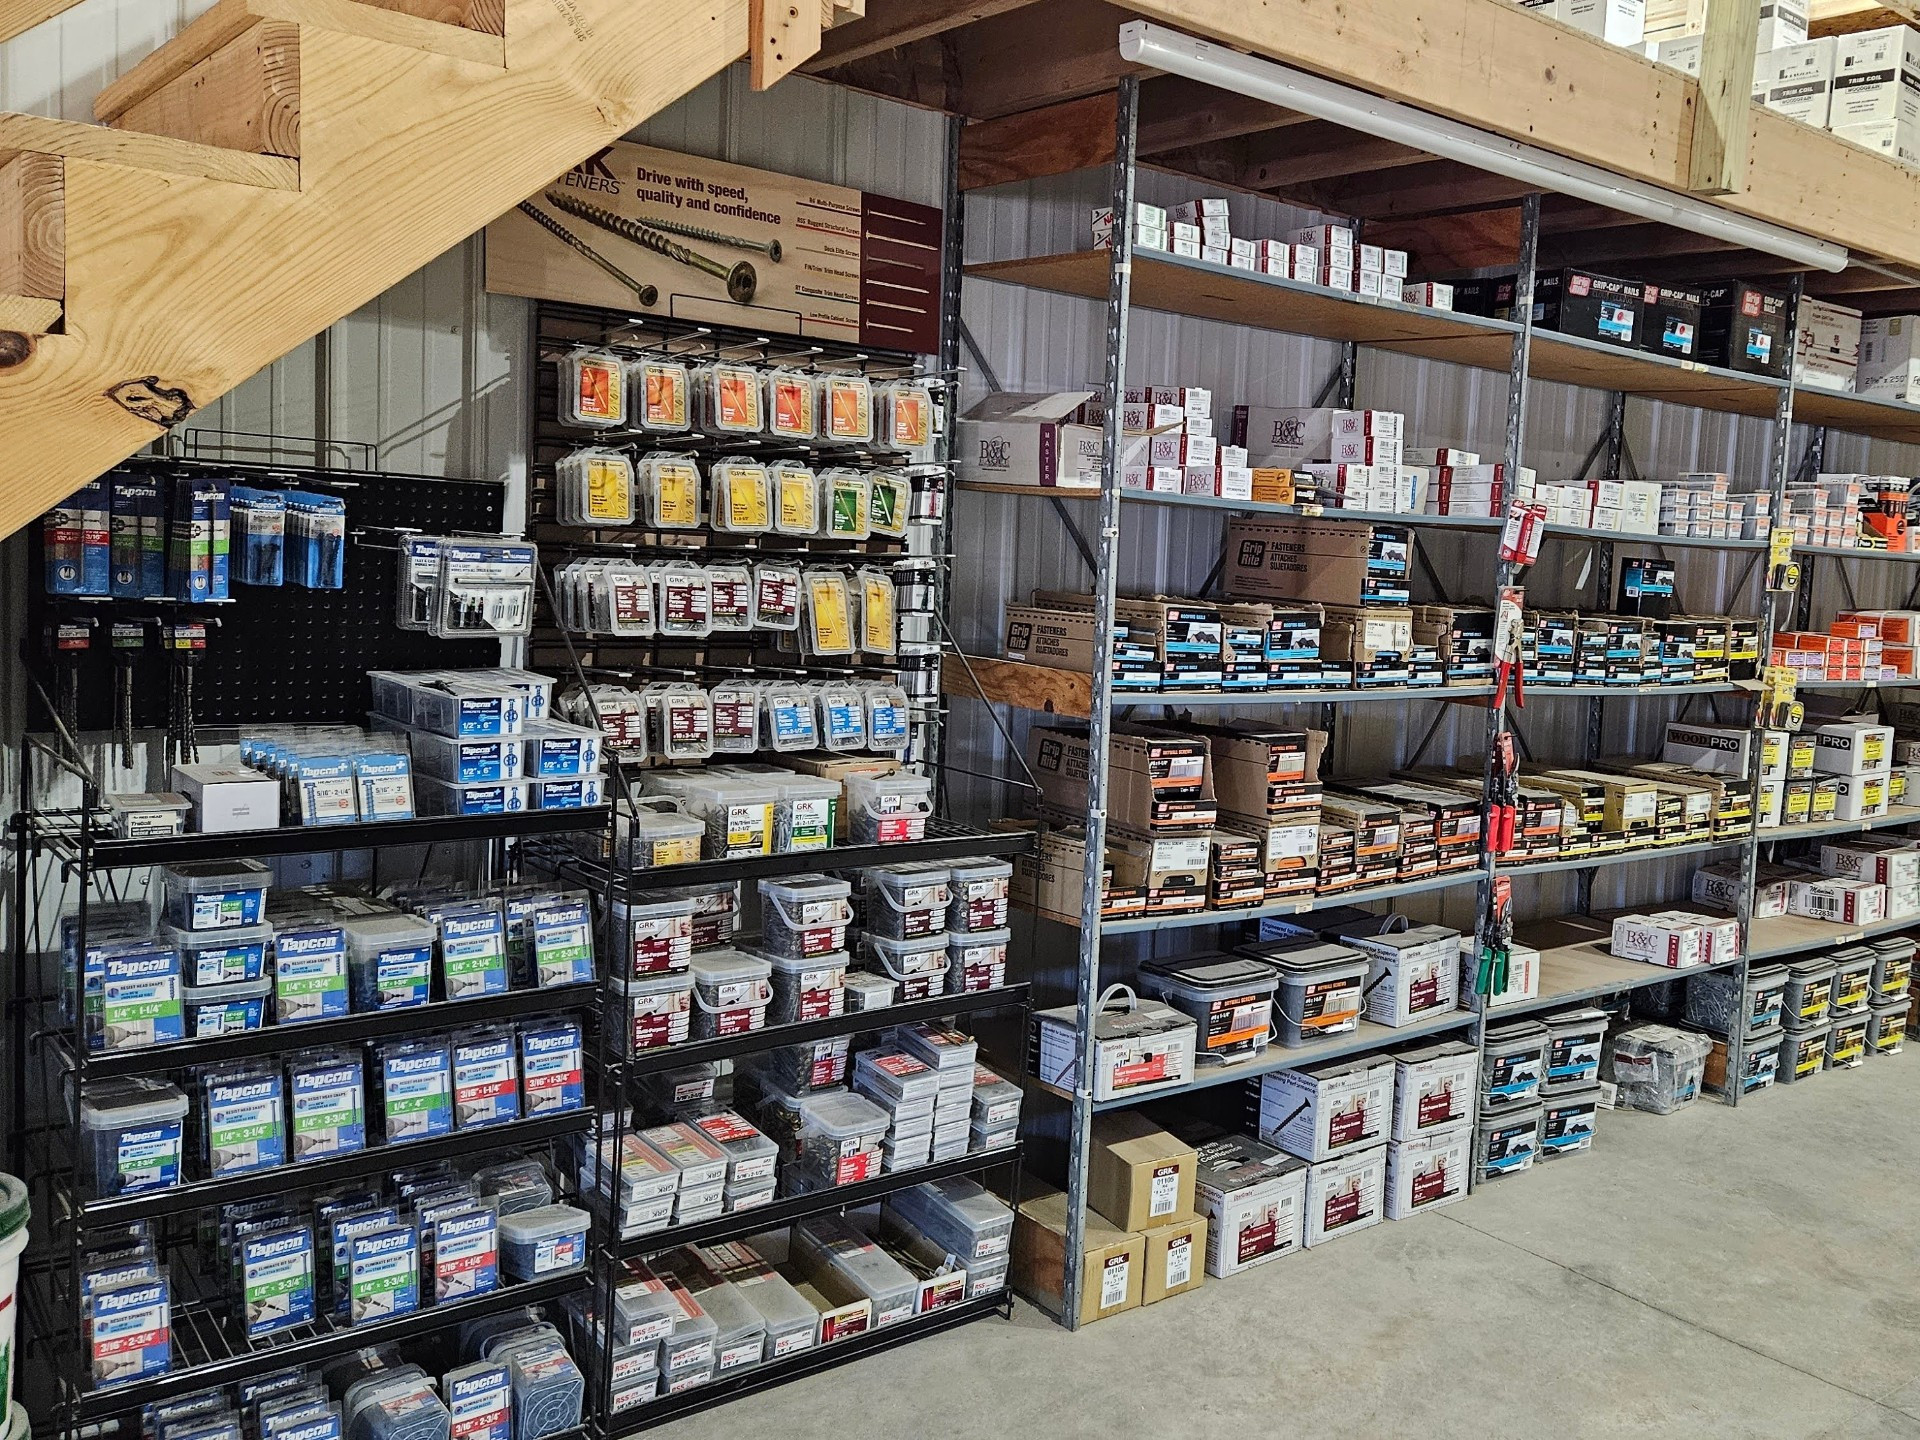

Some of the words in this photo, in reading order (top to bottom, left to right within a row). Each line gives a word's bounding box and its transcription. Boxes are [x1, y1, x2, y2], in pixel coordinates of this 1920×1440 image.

[1848, 76, 1865, 84] TRIM
[1866, 74, 1882, 82] COIL
[1781, 89, 1799, 97] TRIM
[1799, 86, 1814, 94] COIL
[1847, 84, 1881, 93] WOODGRAIN
[637, 166, 672, 186] Drive
[675, 176, 704, 192] with
[707, 183, 749, 203] speed,
[636, 187, 683, 209] quality
[686, 196, 710, 212] and
[714, 200, 782, 225] confidence
[817, 199, 845, 210] Multi-Purpose
[846, 205, 860, 213] Screws
[807, 219, 824, 229] Rugged
[824, 222, 844, 231] Structural
[845, 226, 860, 235] Screws
[835, 247, 844, 255] Elite
[845, 249, 860, 258] Screws
[824, 266, 833, 275] Trim
[833, 268, 844, 277] Head
[1543, 276, 1559, 287] NAILS
[801, 286, 823, 295] Composite
[824, 289, 833, 298] Trim
[833, 291, 844, 299] Head
[1623, 283, 1640, 297] NAILS
[1686, 293, 1700, 303] NAILS
[1272, 420, 1306, 439] B&C
[979, 440, 1011, 461] B&C
[1242, 541, 1263, 554] Grip
[1271, 542, 1306, 552] FASTENERS
[1240, 553, 1260, 566] Rite
[1269, 553, 1298, 563] ATTACHES
[1269, 562, 1308, 573] SUJETADORES
[1011, 625, 1030, 638] Grip
[1036, 625, 1068, 637] FASTENERS
[1009, 637, 1027, 649] Rite
[1035, 637, 1060, 647] ATTACHES
[1035, 644, 1069, 657] SUJETADORES
[462, 721, 477, 729] 1/2"
[483, 721, 492, 729] 6"
[1710, 735, 1739, 750] PRO
[1822, 736, 1850, 749] PRO
[1042, 742, 1060, 757] Grip
[543, 761, 557, 769] 1/2"
[1040, 756, 1058, 771] Rite
[1066, 757, 1088, 771] ATTACHE
[483, 766, 492, 774] 6"
[731, 808, 749, 816] GRK
[796, 802, 814, 810] GRK
[1308, 828, 1313, 838] 5
[1200, 841, 1205, 852] 5
[1835, 853, 1864, 867] B&C
[1705, 879, 1736, 897] B&C
[1809, 908, 1835, 918] C22838
[445, 918, 495, 935] Tapcon
[638, 920, 655, 929] GRK
[1261, 921, 1284, 933] Engineered
[1261, 927, 1287, 939] Fastening
[1626, 930, 1659, 948] B&C
[280, 936, 338, 953] Tapcon
[1368, 945, 1376, 953] for
[1376, 947, 1398, 957] Superior
[107, 958, 172, 977] Tapcon
[452, 962, 466, 972] 1/4"
[471, 958, 492, 968] 2-1/4"
[285, 982, 301, 992] 1/4"
[308, 979, 331, 989] 1-3/4"
[721, 985, 737, 994] GRK
[638, 997, 654, 1005] GRK
[113, 1008, 131, 1019] 1/4"
[138, 1004, 164, 1015] 1-1/4"
[527, 1034, 575, 1051] Tapcon
[456, 1043, 507, 1061] Tapcon
[388, 1055, 441, 1073] Tapcon
[296, 1070, 353, 1088] Tapcon
[550, 1073, 570, 1084] 1-3/4"
[1264, 1073, 1286, 1085] Fastening
[1286, 1079, 1316, 1094] Performance
[1286, 1072, 1297, 1080] for
[1297, 1076, 1318, 1088] Superior
[213, 1082, 273, 1102] Tapcon
[460, 1088, 479, 1099] 3/16"
[414, 1098, 423, 1108] 4"
[324, 1113, 349, 1124] 3-3/4"
[243, 1125, 268, 1138] 3-1/4"
[1206, 1141, 1219, 1149] with
[1210, 1142, 1234, 1154] Quality
[1200, 1145, 1243, 1163] Confidence
[1157, 1167, 1175, 1176] GRK
[1156, 1176, 1175, 1186] 01105
[248, 1235, 304, 1259] Tapcon
[978, 1242, 989, 1250] RSS
[1171, 1236, 1188, 1248] GRK
[1171, 1246, 1188, 1257] 01105
[439, 1263, 458, 1274] 3/16"
[464, 1256, 484, 1267] 1-1/4"
[1108, 1256, 1125, 1266] GRK
[1107, 1266, 1125, 1276] 01105
[277, 1277, 303, 1291] 3-3/4"
[383, 1274, 408, 1287] 3-3/4"
[974, 1282, 986, 1290] RSS
[98, 1287, 162, 1310] Tapcon
[879, 1314, 891, 1323] RSS
[631, 1328, 646, 1338] RSS
[100, 1341, 122, 1353] 3/16"
[128, 1332, 156, 1347] 2-3/4"
[776, 1340, 790, 1349] RSS
[722, 1353, 736, 1362] RSS
[615, 1362, 629, 1372] RSS
[615, 1394, 630, 1404] RSS
[479, 1411, 501, 1425] 2-3/4"
